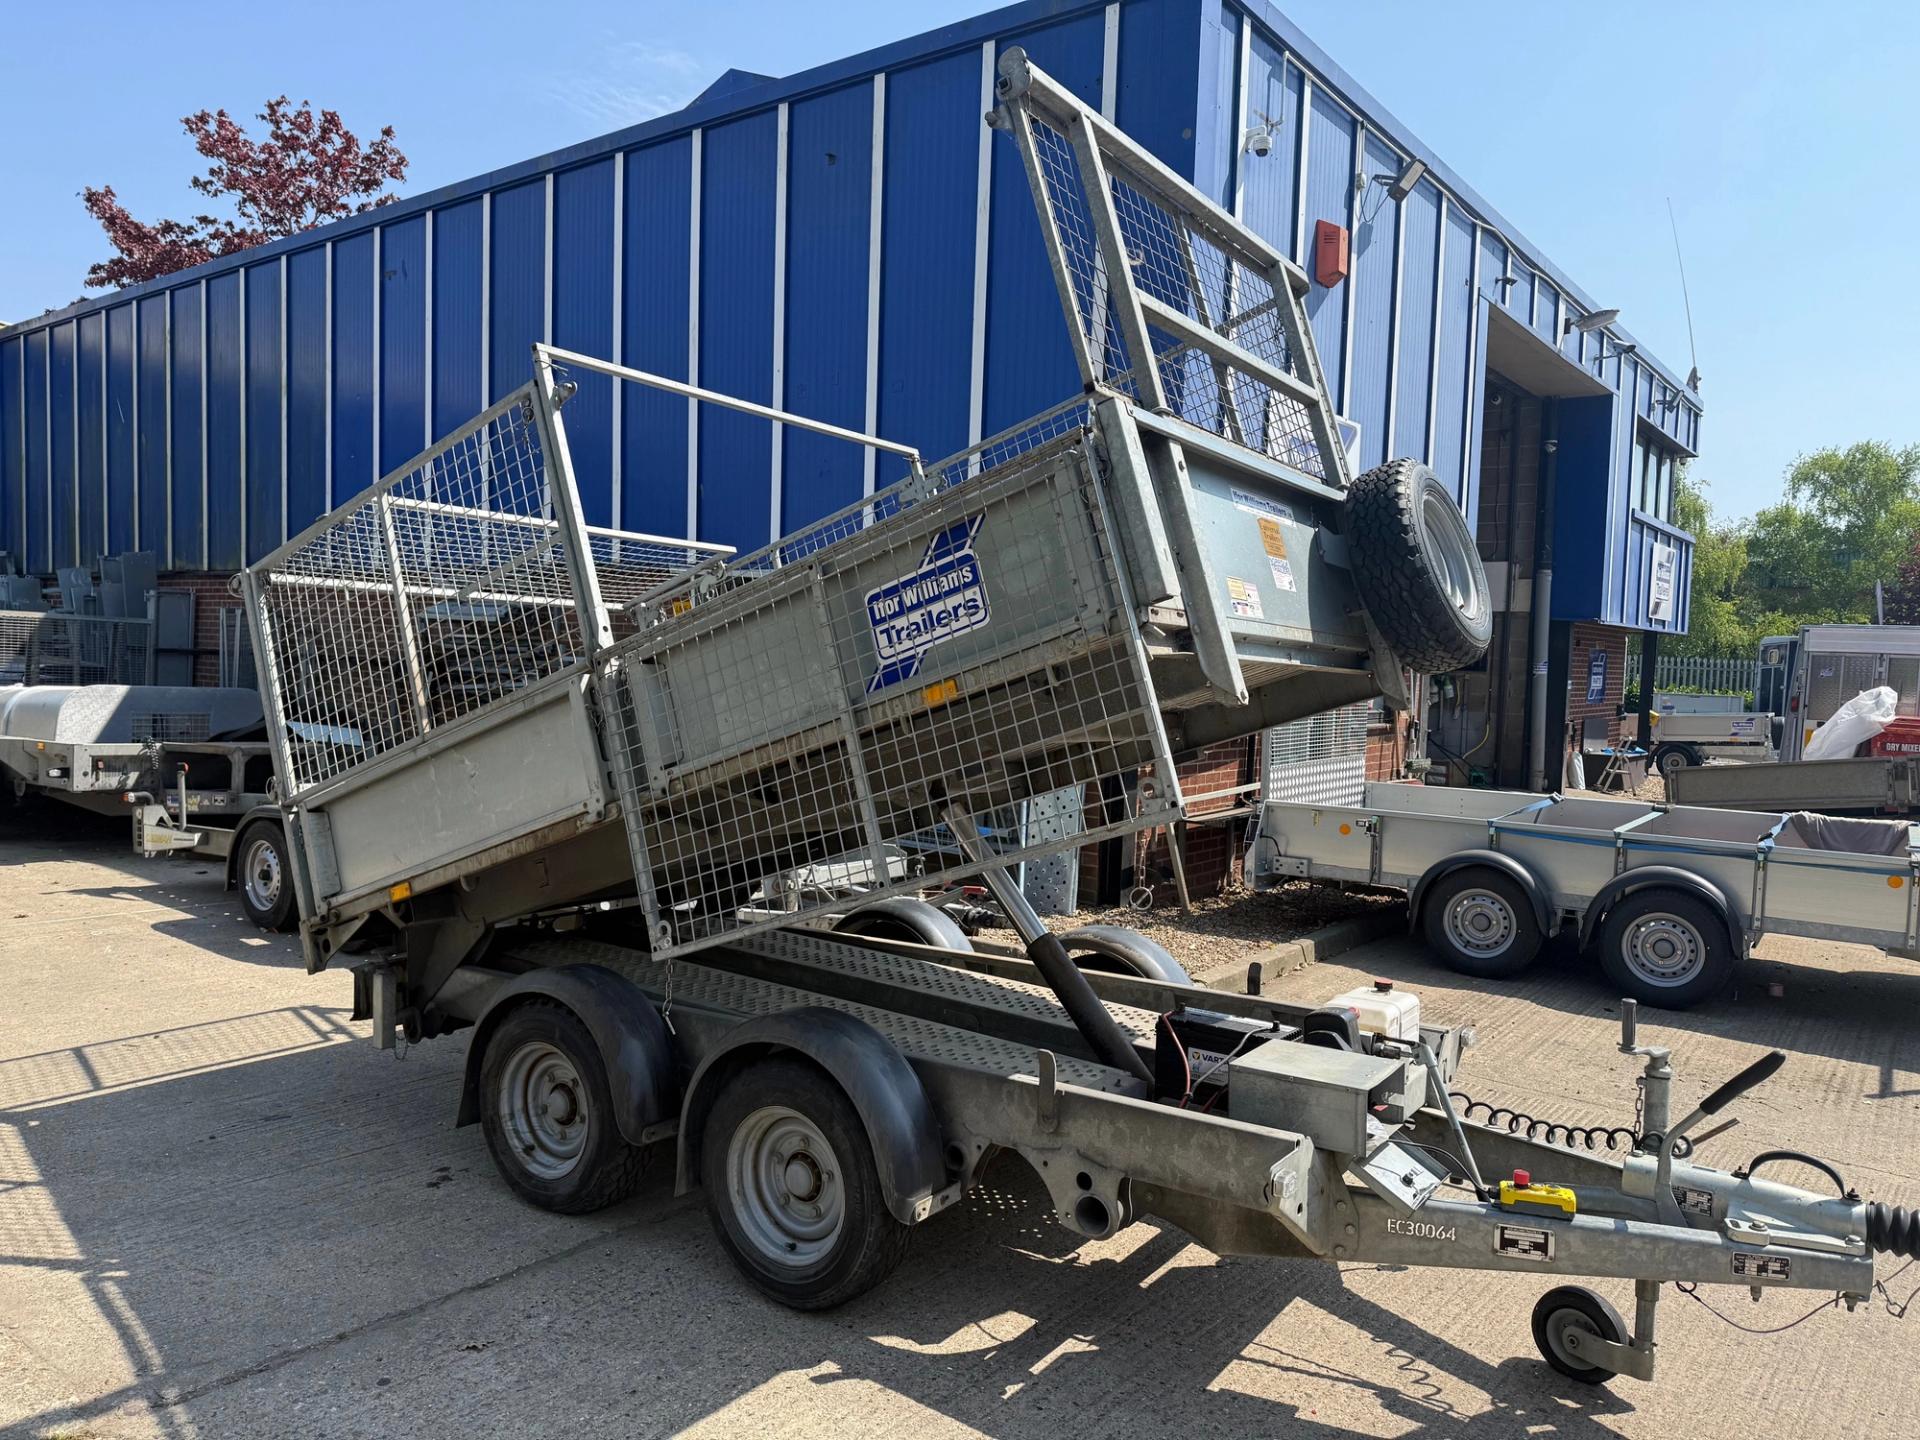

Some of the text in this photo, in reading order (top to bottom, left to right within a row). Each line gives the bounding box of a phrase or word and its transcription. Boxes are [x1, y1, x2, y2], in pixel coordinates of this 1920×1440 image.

[902, 566, 974, 608] Williams
[879, 597, 980, 649] Trailers
[1387, 1218, 1457, 1241] EC30064
